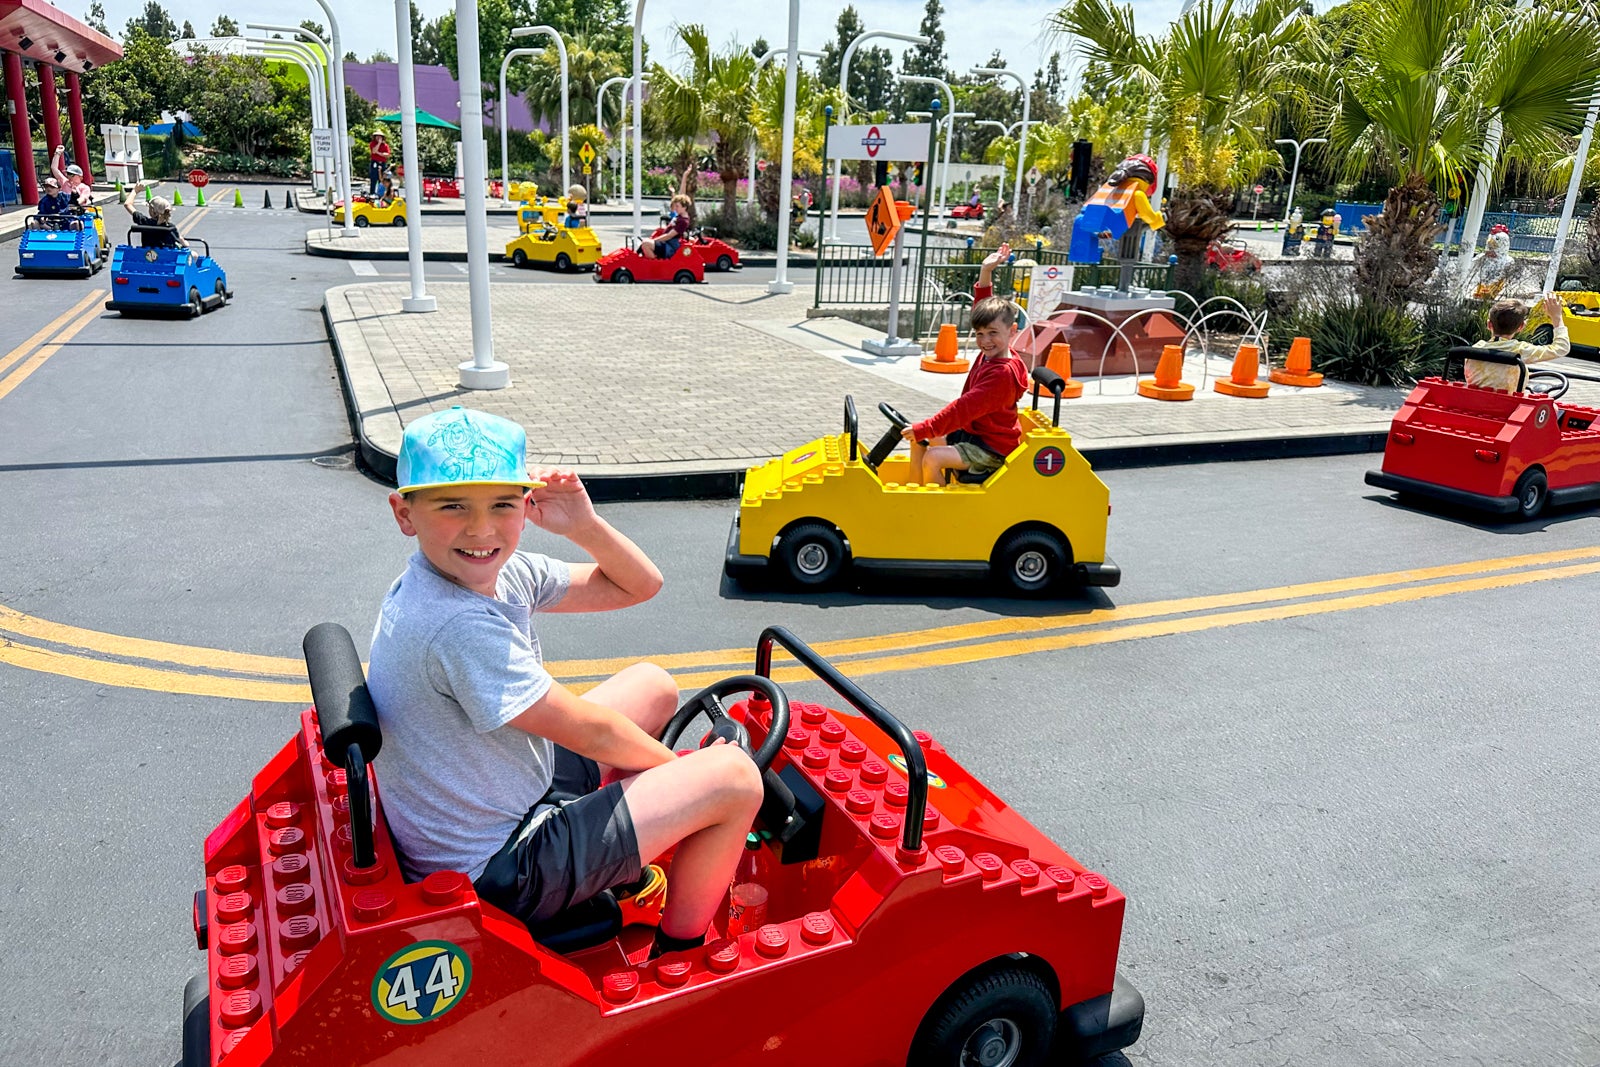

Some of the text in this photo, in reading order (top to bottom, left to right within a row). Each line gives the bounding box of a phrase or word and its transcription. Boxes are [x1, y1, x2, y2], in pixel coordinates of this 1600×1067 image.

[189, 174, 208, 183] STOP
[1538, 409, 1546, 423] 8
[1044, 453, 1052, 470] 1
[938, 846, 961, 861] LEGO
[975, 854, 999, 868] LEGO
[1013, 860, 1036, 874] LEGO
[1049, 867, 1072, 881] LEGO
[1082, 873, 1105, 887] LEGO
[807, 914, 830, 932] LEGO
[387, 953, 458, 1010] 44
